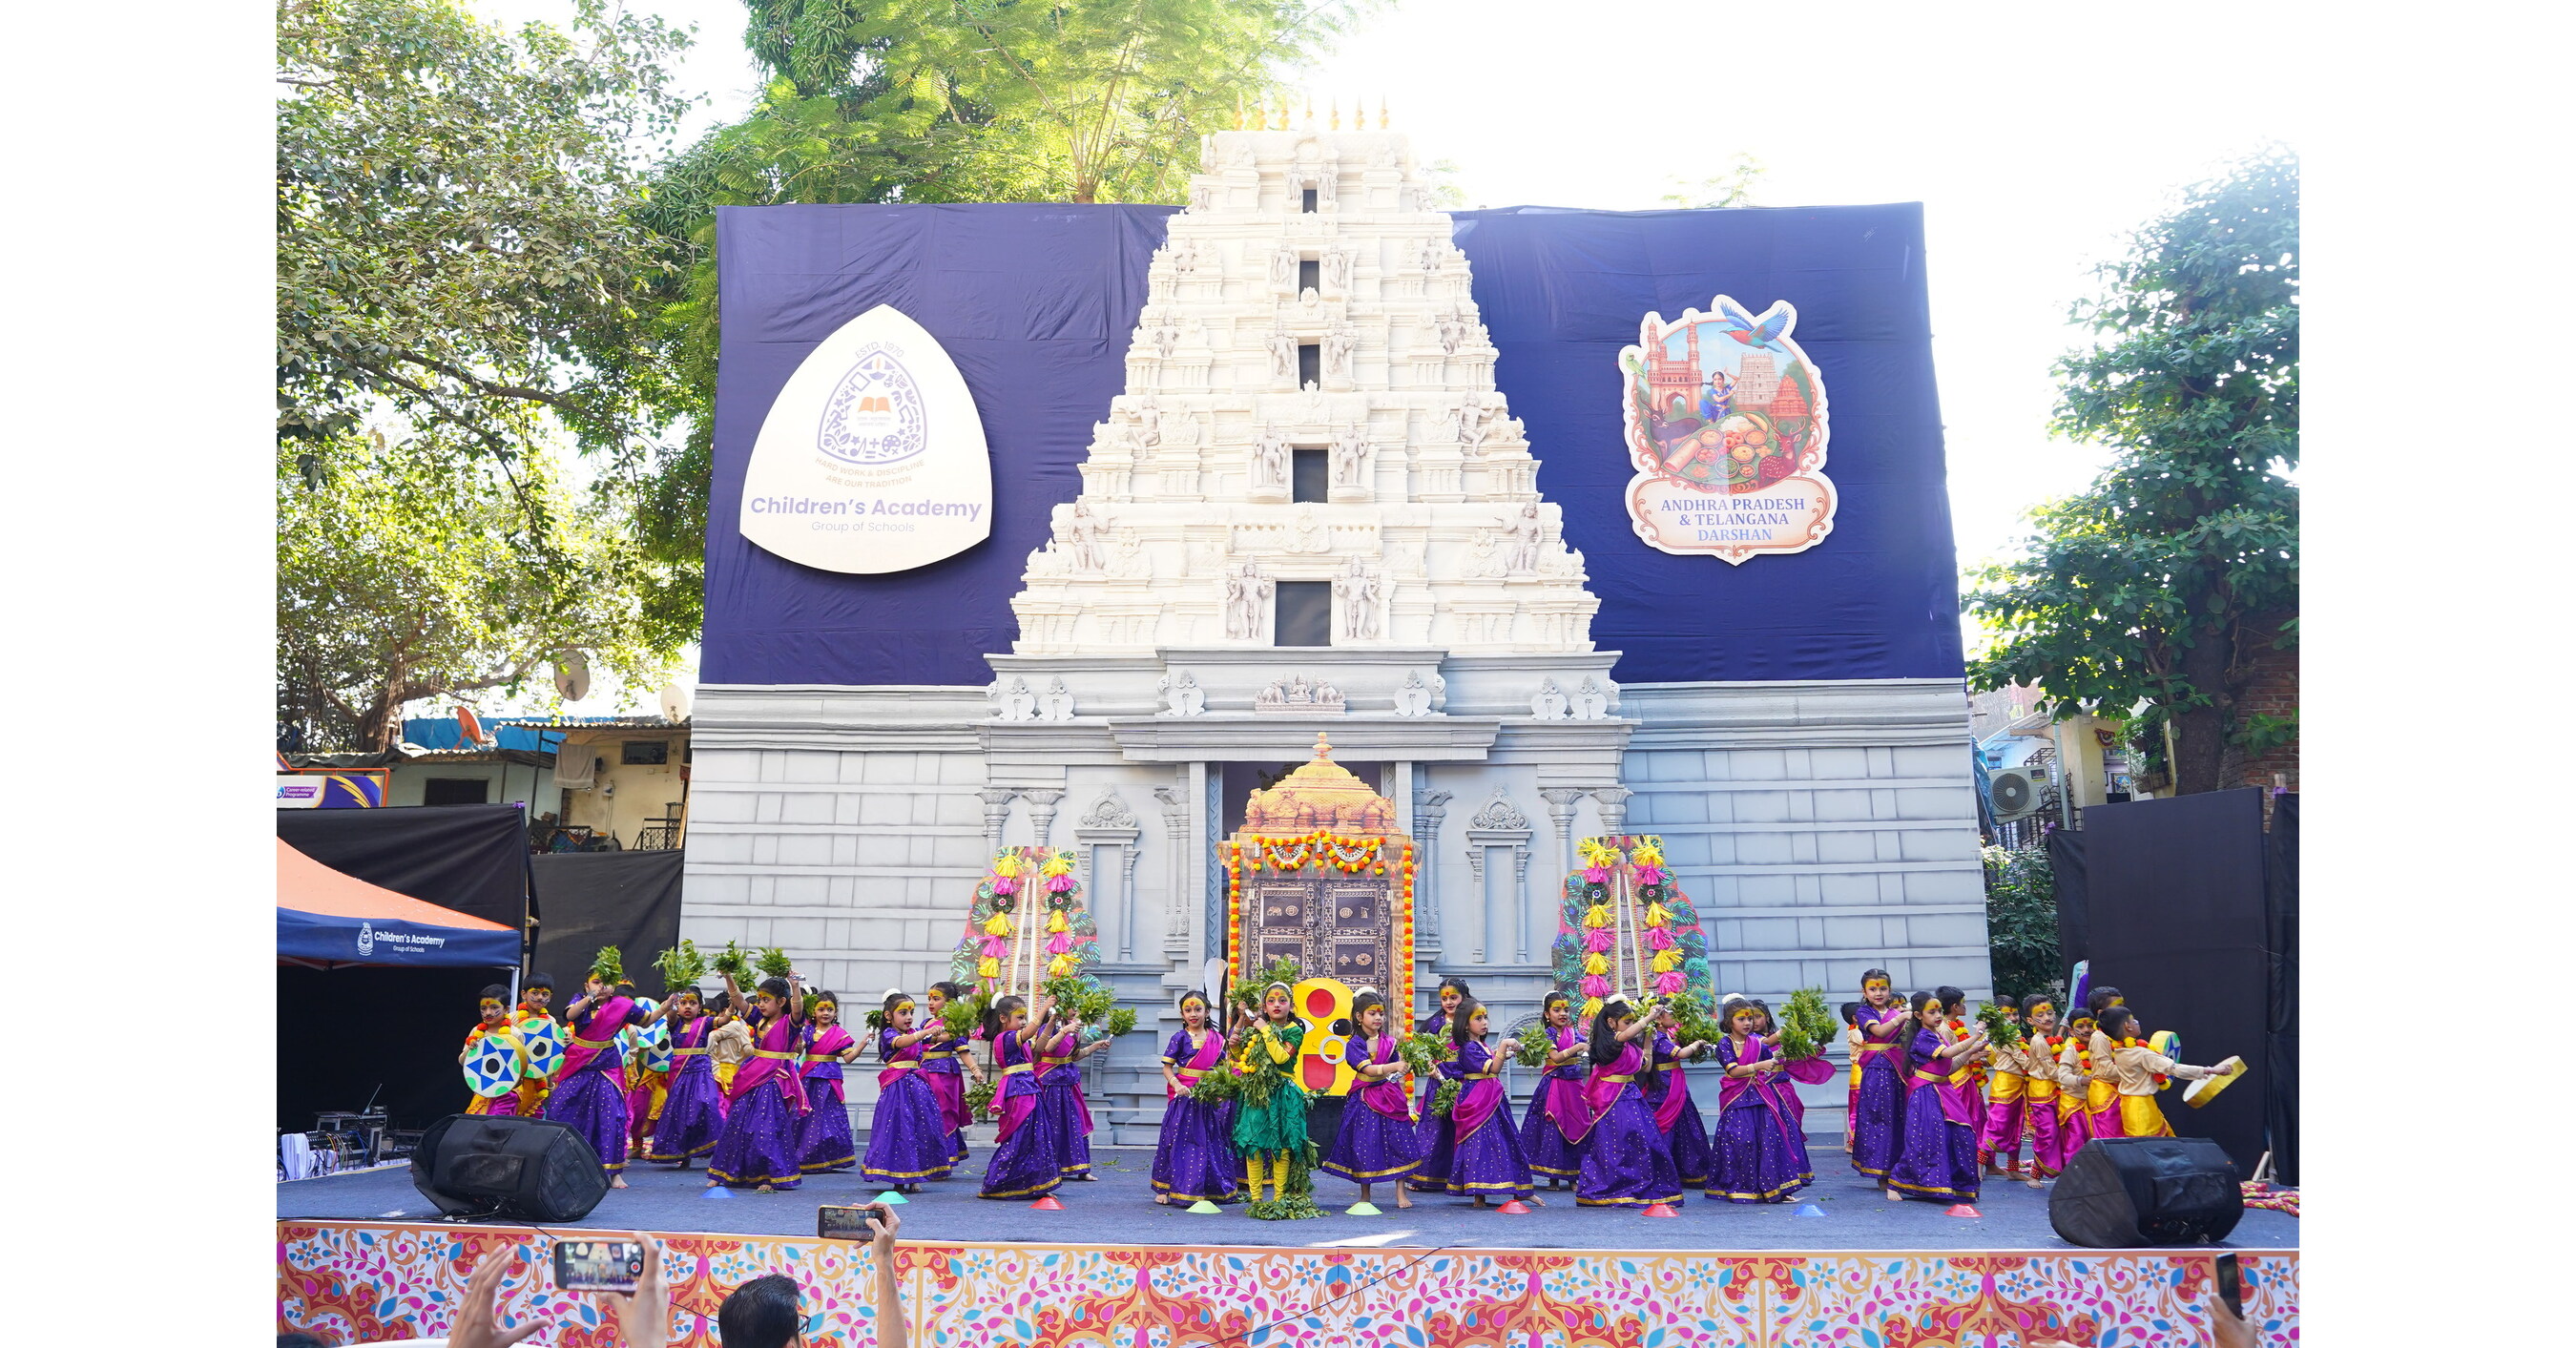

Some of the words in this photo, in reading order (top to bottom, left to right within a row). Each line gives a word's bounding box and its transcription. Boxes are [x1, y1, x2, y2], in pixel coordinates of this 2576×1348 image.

[855, 342, 881, 359] ESTD.
[883, 341, 904, 358] 1970
[815, 457, 838, 471] HARD
[840, 467, 866, 477] WORK
[877, 459, 924, 477] DISCIPLINE
[825, 475, 842, 486] ARE
[844, 479, 863, 487] OUR
[864, 476, 912, 488] TRADITION
[751, 496, 865, 515] Children's
[871, 499, 983, 522] Academy
[1661, 499, 1729, 511] ANDHRA
[1732, 498, 1805, 510] PRADESH
[1679, 513, 1691, 526] &
[1695, 513, 1789, 526] TELANGANA
[811, 521, 849, 534] Group
[852, 522, 864, 532] of
[868, 522, 915, 532] Schools
[1697, 529, 1772, 541] DARSHAN
[374, 931, 410, 944] Children's
[410, 935, 445, 948] Academy
